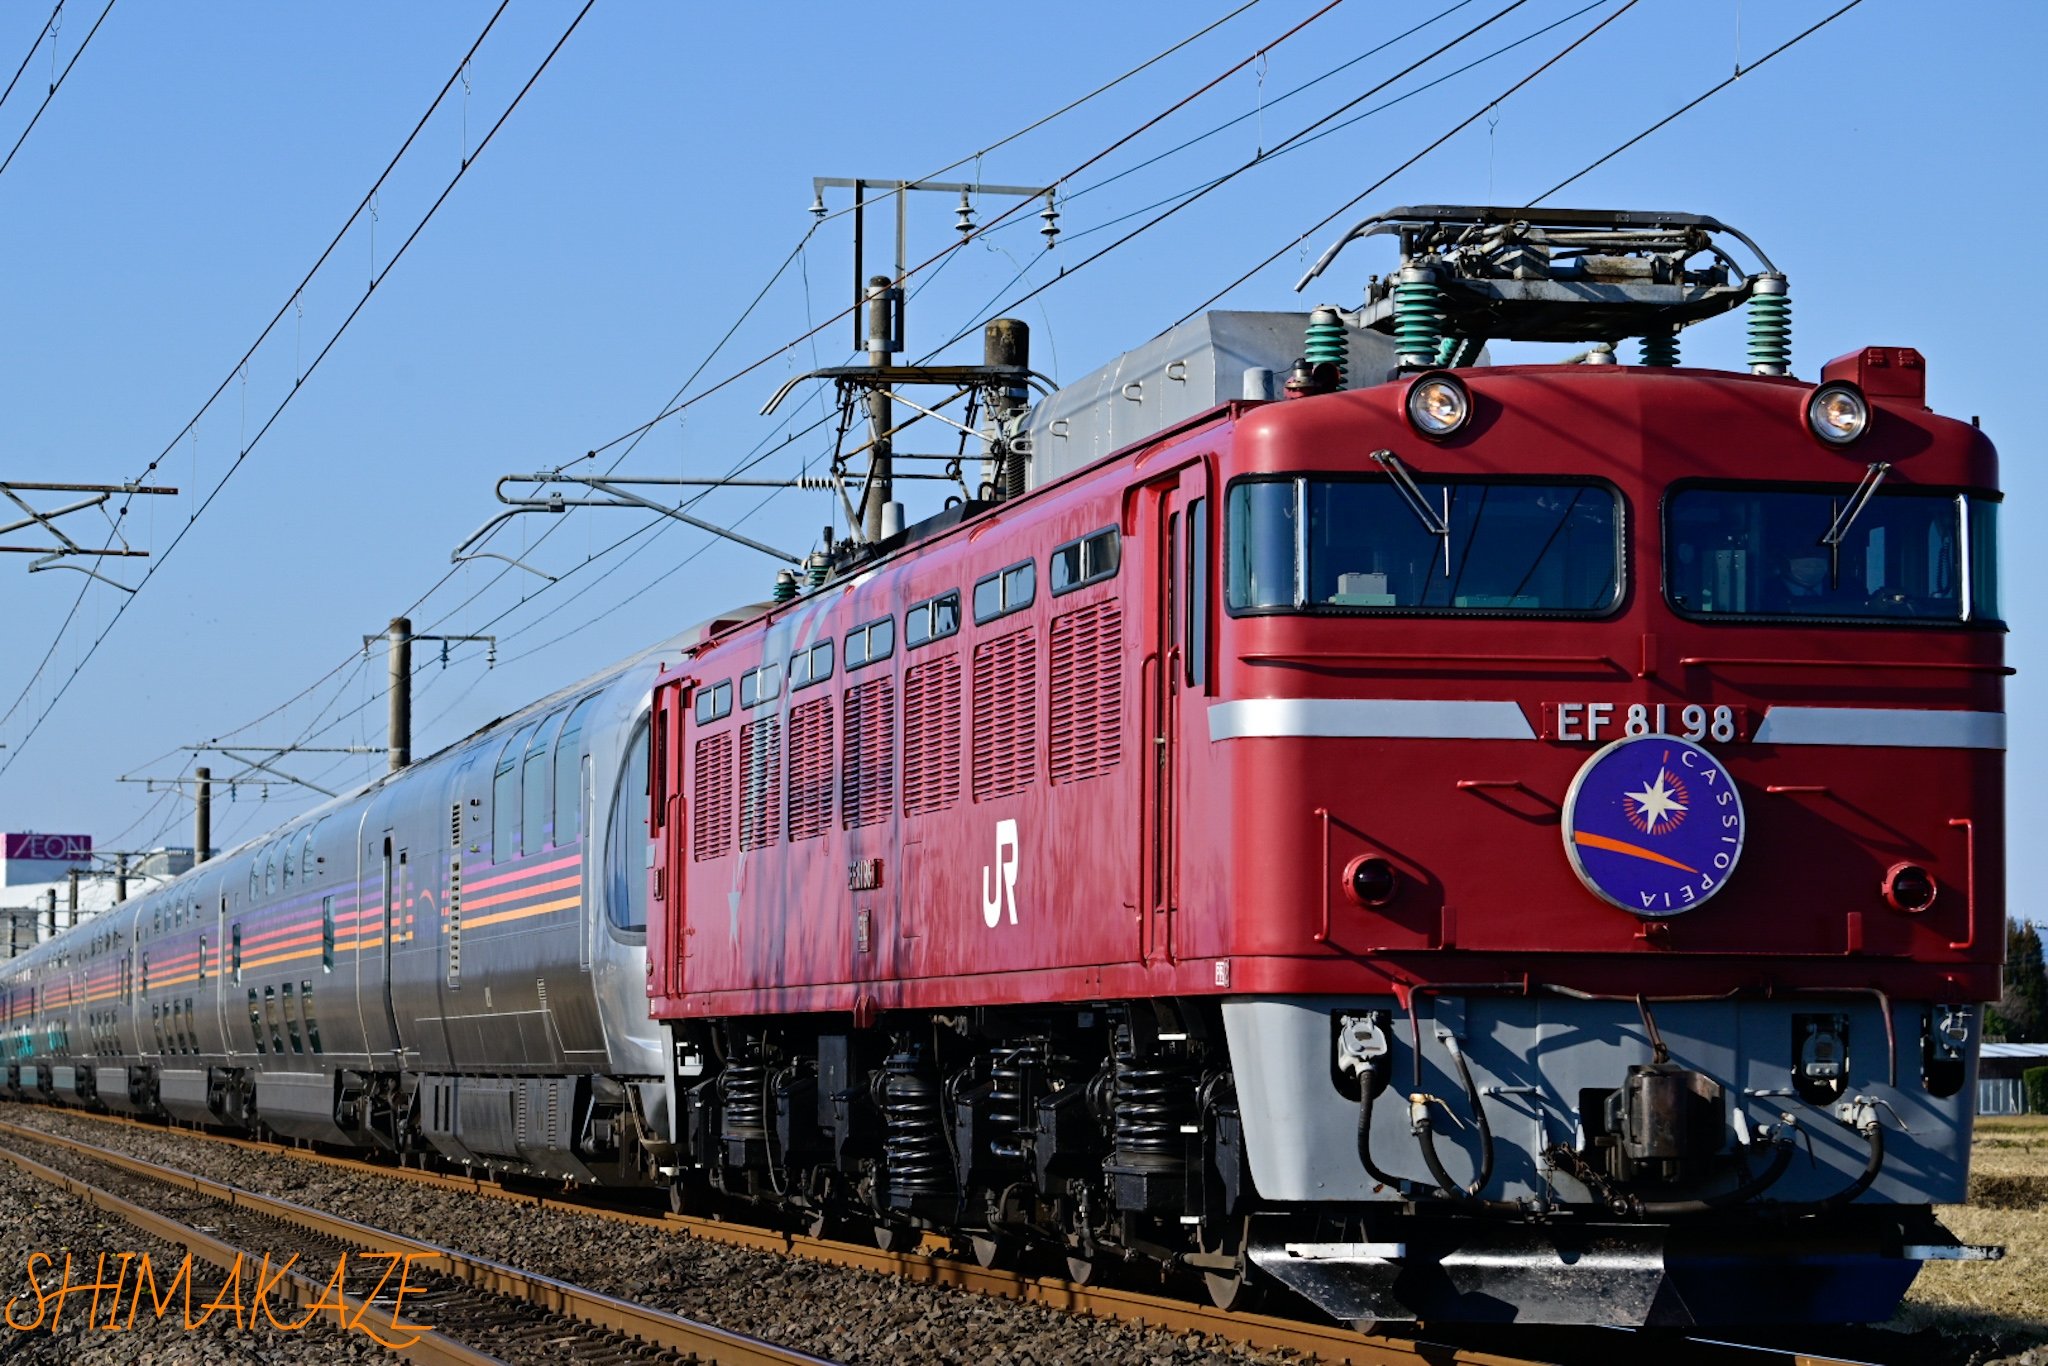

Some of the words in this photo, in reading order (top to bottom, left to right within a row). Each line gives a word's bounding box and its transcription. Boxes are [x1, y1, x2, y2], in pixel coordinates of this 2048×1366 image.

[1557, 703, 1614, 741] EF
[1624, 703, 1666, 738] 81
[1681, 704, 1735, 743] 98
[982, 818, 1019, 928] JR
[1639, 750, 1738, 907] CASSIOPEIA
